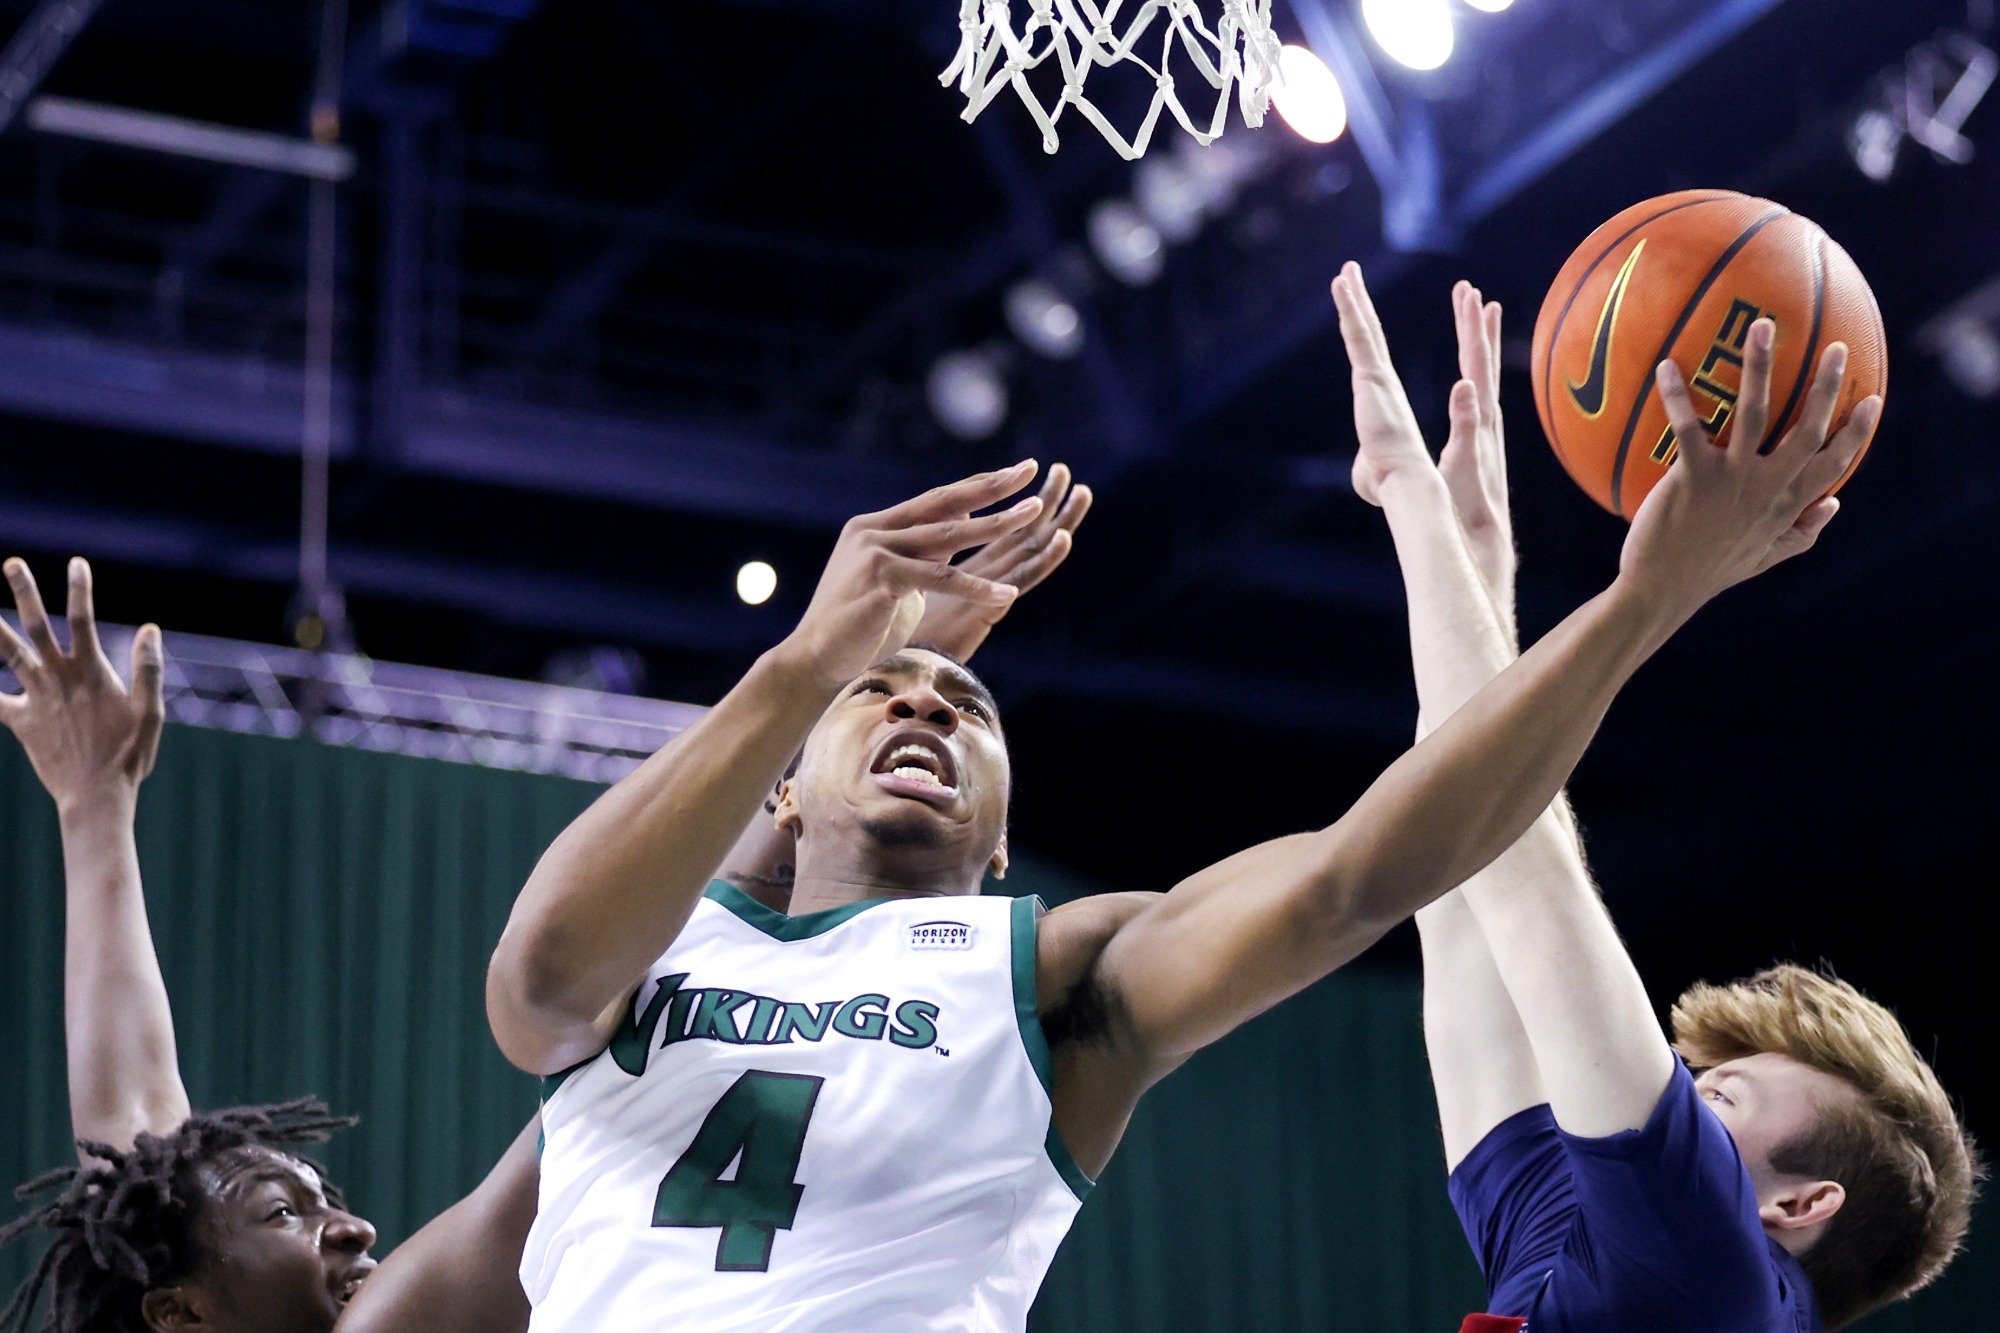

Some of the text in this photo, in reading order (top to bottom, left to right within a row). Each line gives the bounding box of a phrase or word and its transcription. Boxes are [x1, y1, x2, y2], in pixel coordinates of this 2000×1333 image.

[913, 928, 967, 938] HORIZON
[609, 972, 940, 1077] VIKINGS
[651, 1069, 825, 1272] 4
